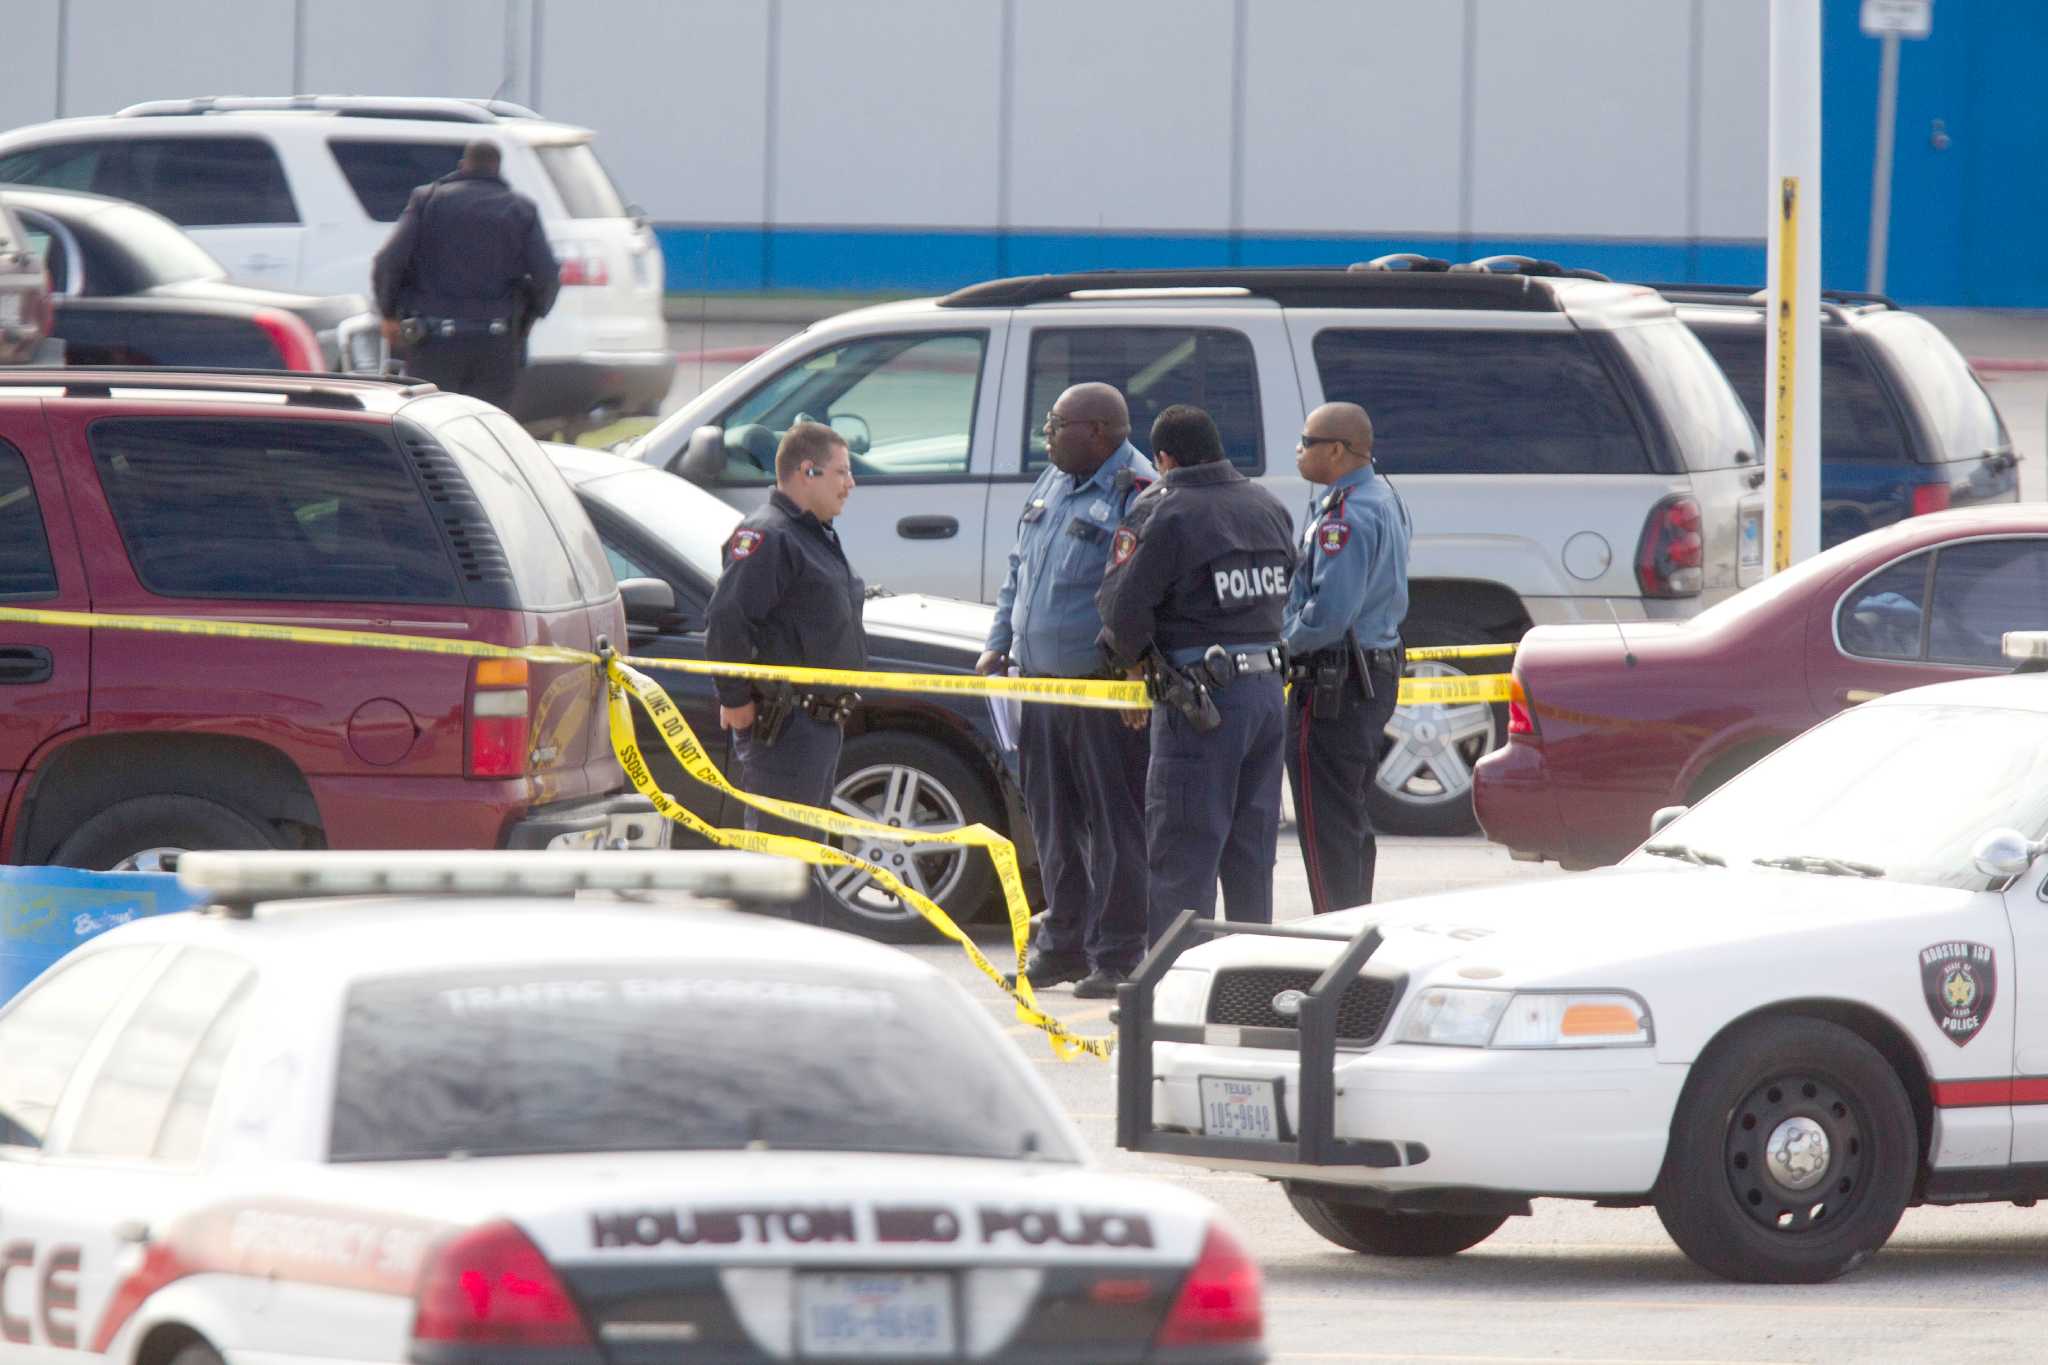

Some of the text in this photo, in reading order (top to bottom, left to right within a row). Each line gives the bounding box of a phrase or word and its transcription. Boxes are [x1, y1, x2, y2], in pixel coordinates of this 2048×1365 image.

[1214, 566, 1287, 600] POLICE
[645, 689, 671, 716] LINE
[662, 716, 693, 738] DO
[676, 737, 701, 764] NOT
[620, 744, 649, 788] CROSS
[649, 789, 672, 812] NOT
[1923, 943, 1990, 965] HOUSTON ISD
[1942, 1016, 1979, 1030] POLICE
[1224, 1083, 1253, 1096] TEXAS
[593, 1208, 856, 1247] HOUSTON
[977, 1209, 1155, 1248] POLICE
